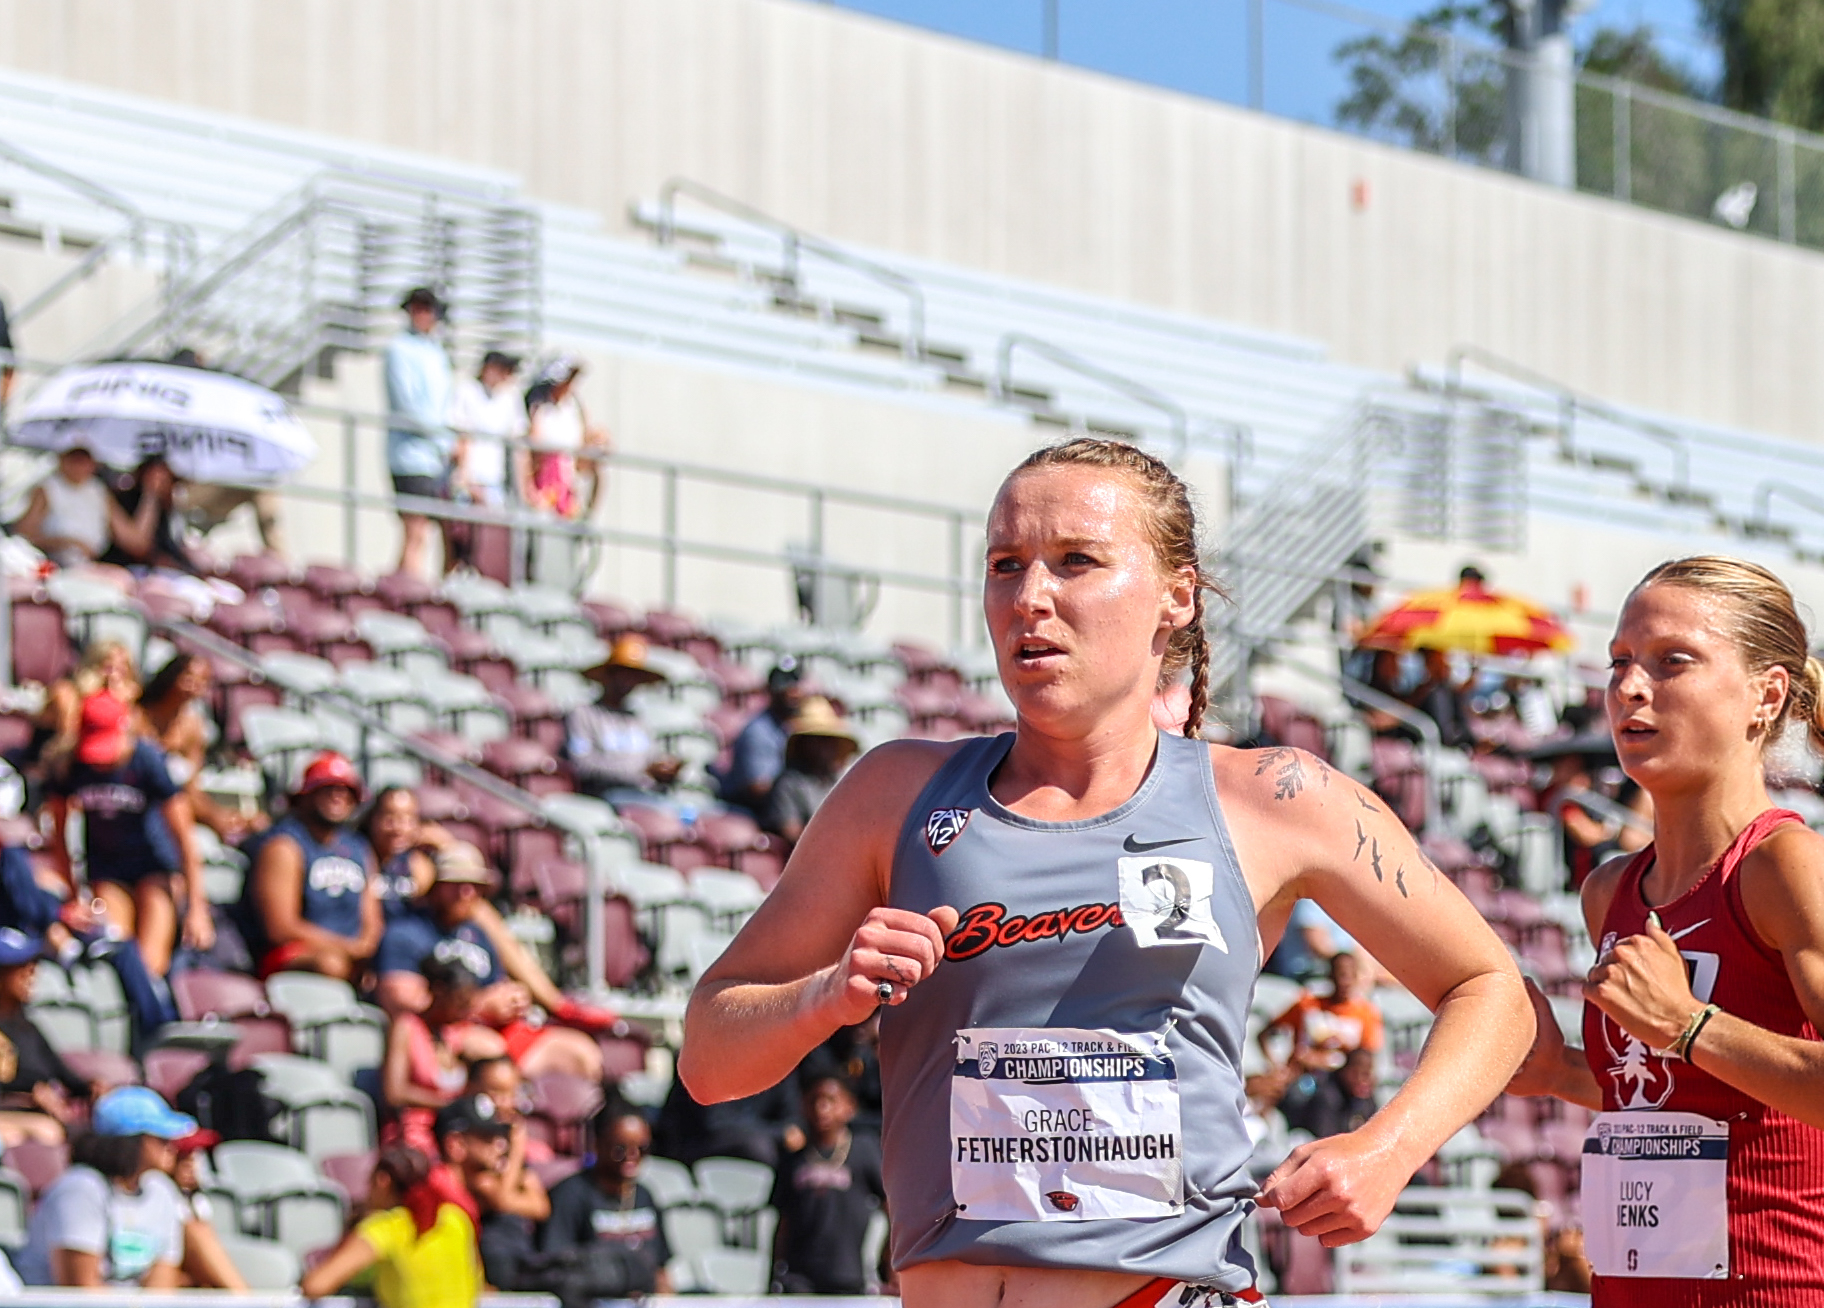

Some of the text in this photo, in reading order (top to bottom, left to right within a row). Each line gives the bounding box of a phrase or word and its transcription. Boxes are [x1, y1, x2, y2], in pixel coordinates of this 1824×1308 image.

[1142, 863, 1206, 940] 2
[1004, 1042, 1028, 1055] 2023
[1031, 1041, 1068, 1054] PAC-12
[1072, 1041, 1104, 1053] TRACK
[1107, 1041, 1115, 1053] &
[1004, 1058, 1145, 1080] CHAMPIONSHIPS
[1024, 1108, 1093, 1134] GRACE
[1647, 1124, 1670, 1134] TRACK
[1672, 1124, 1678, 1134] &
[1680, 1125, 1704, 1135] FIELD
[956, 1134, 1175, 1164] FETHERSTONHAUGH
[1612, 1138, 1701, 1156] CHAMPIONSHIPS
[1620, 1181, 1653, 1201] LUCY
[1616, 1205, 1659, 1228] JENKS
